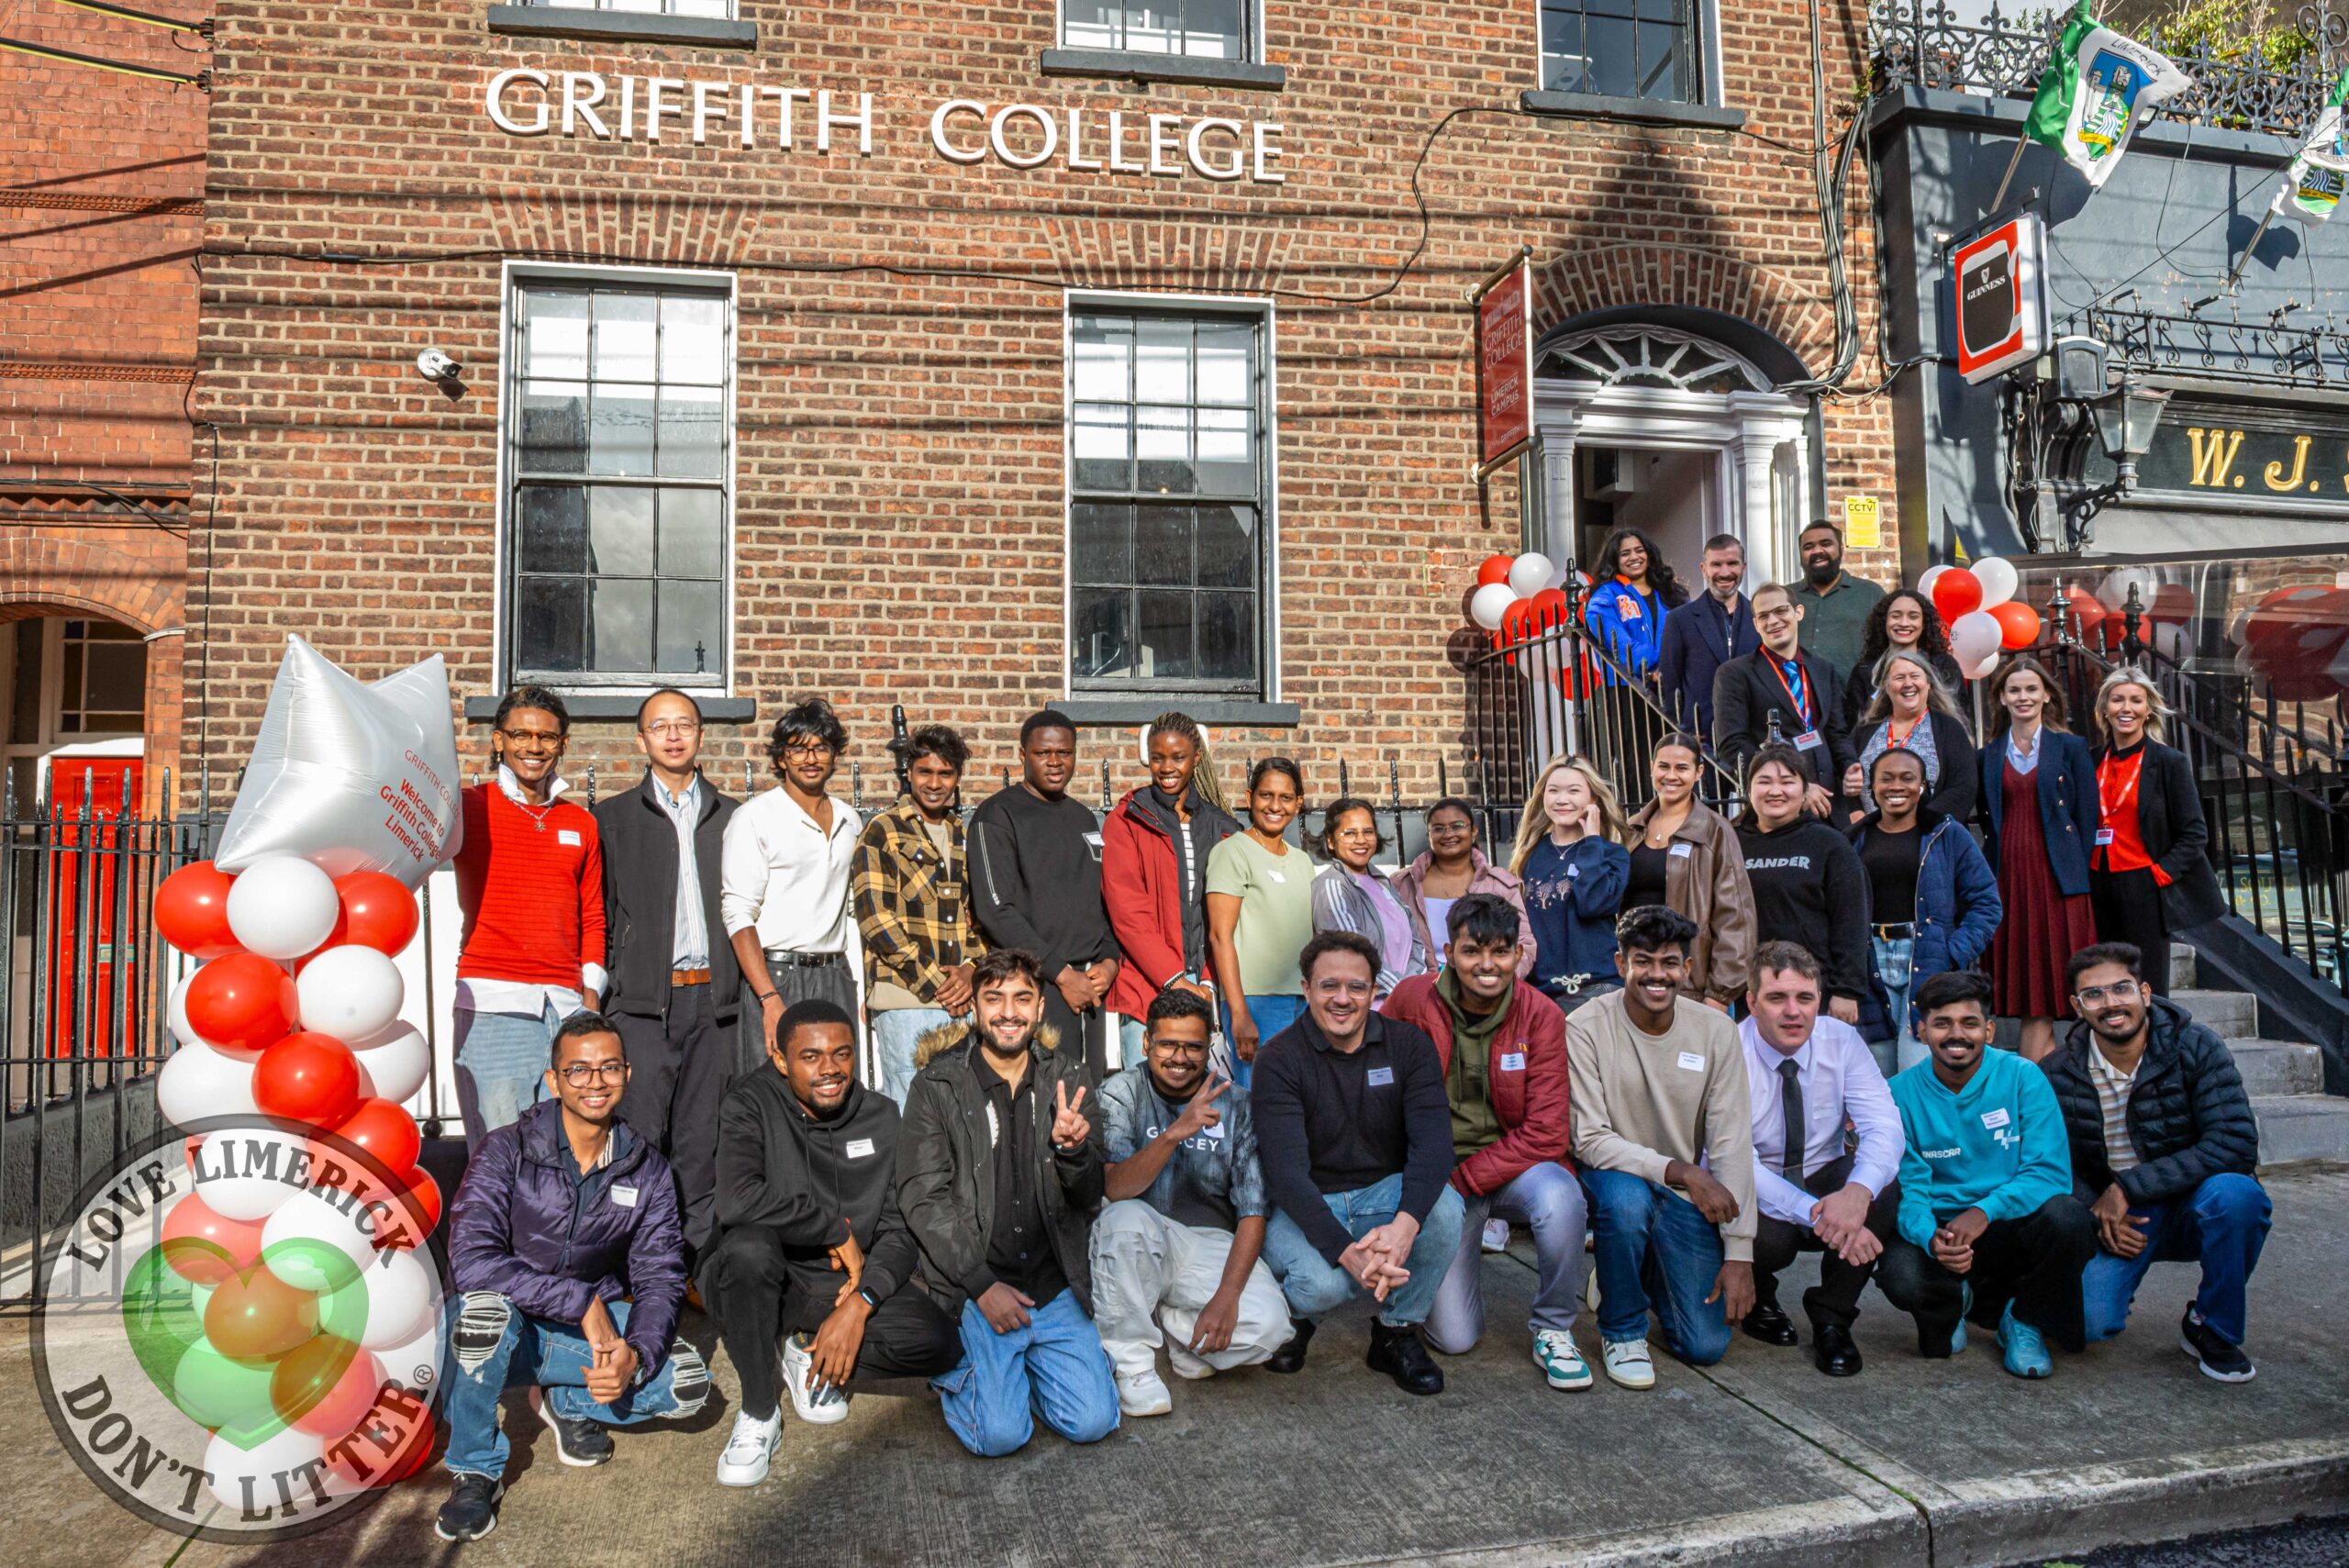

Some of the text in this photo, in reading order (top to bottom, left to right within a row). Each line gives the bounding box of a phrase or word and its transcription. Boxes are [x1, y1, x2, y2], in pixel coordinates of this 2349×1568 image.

[2111, 38, 2167, 77] LIMERICK
[485, 68, 1286, 184] GRIFFITH COLLEGE
[1966, 275, 2006, 301] GUINNESS
[1485, 309, 1522, 351] GRIFFITH
[1485, 329, 1523, 370] COLLEGE
[1490, 375, 1519, 404] LIMERICK
[1491, 389, 1520, 417] CAMPUS
[2187, 427, 2245, 489] W.
[2264, 435, 2320, 494] J.
[1847, 503, 1873, 512] CCTV
[405, 749, 441, 790] GRIFFITH
[380, 784, 441, 860] Griffith College
[399, 777, 445, 838] Welcome to
[384, 814, 424, 862] Limerick
[1745, 855, 1810, 870] SANDER
